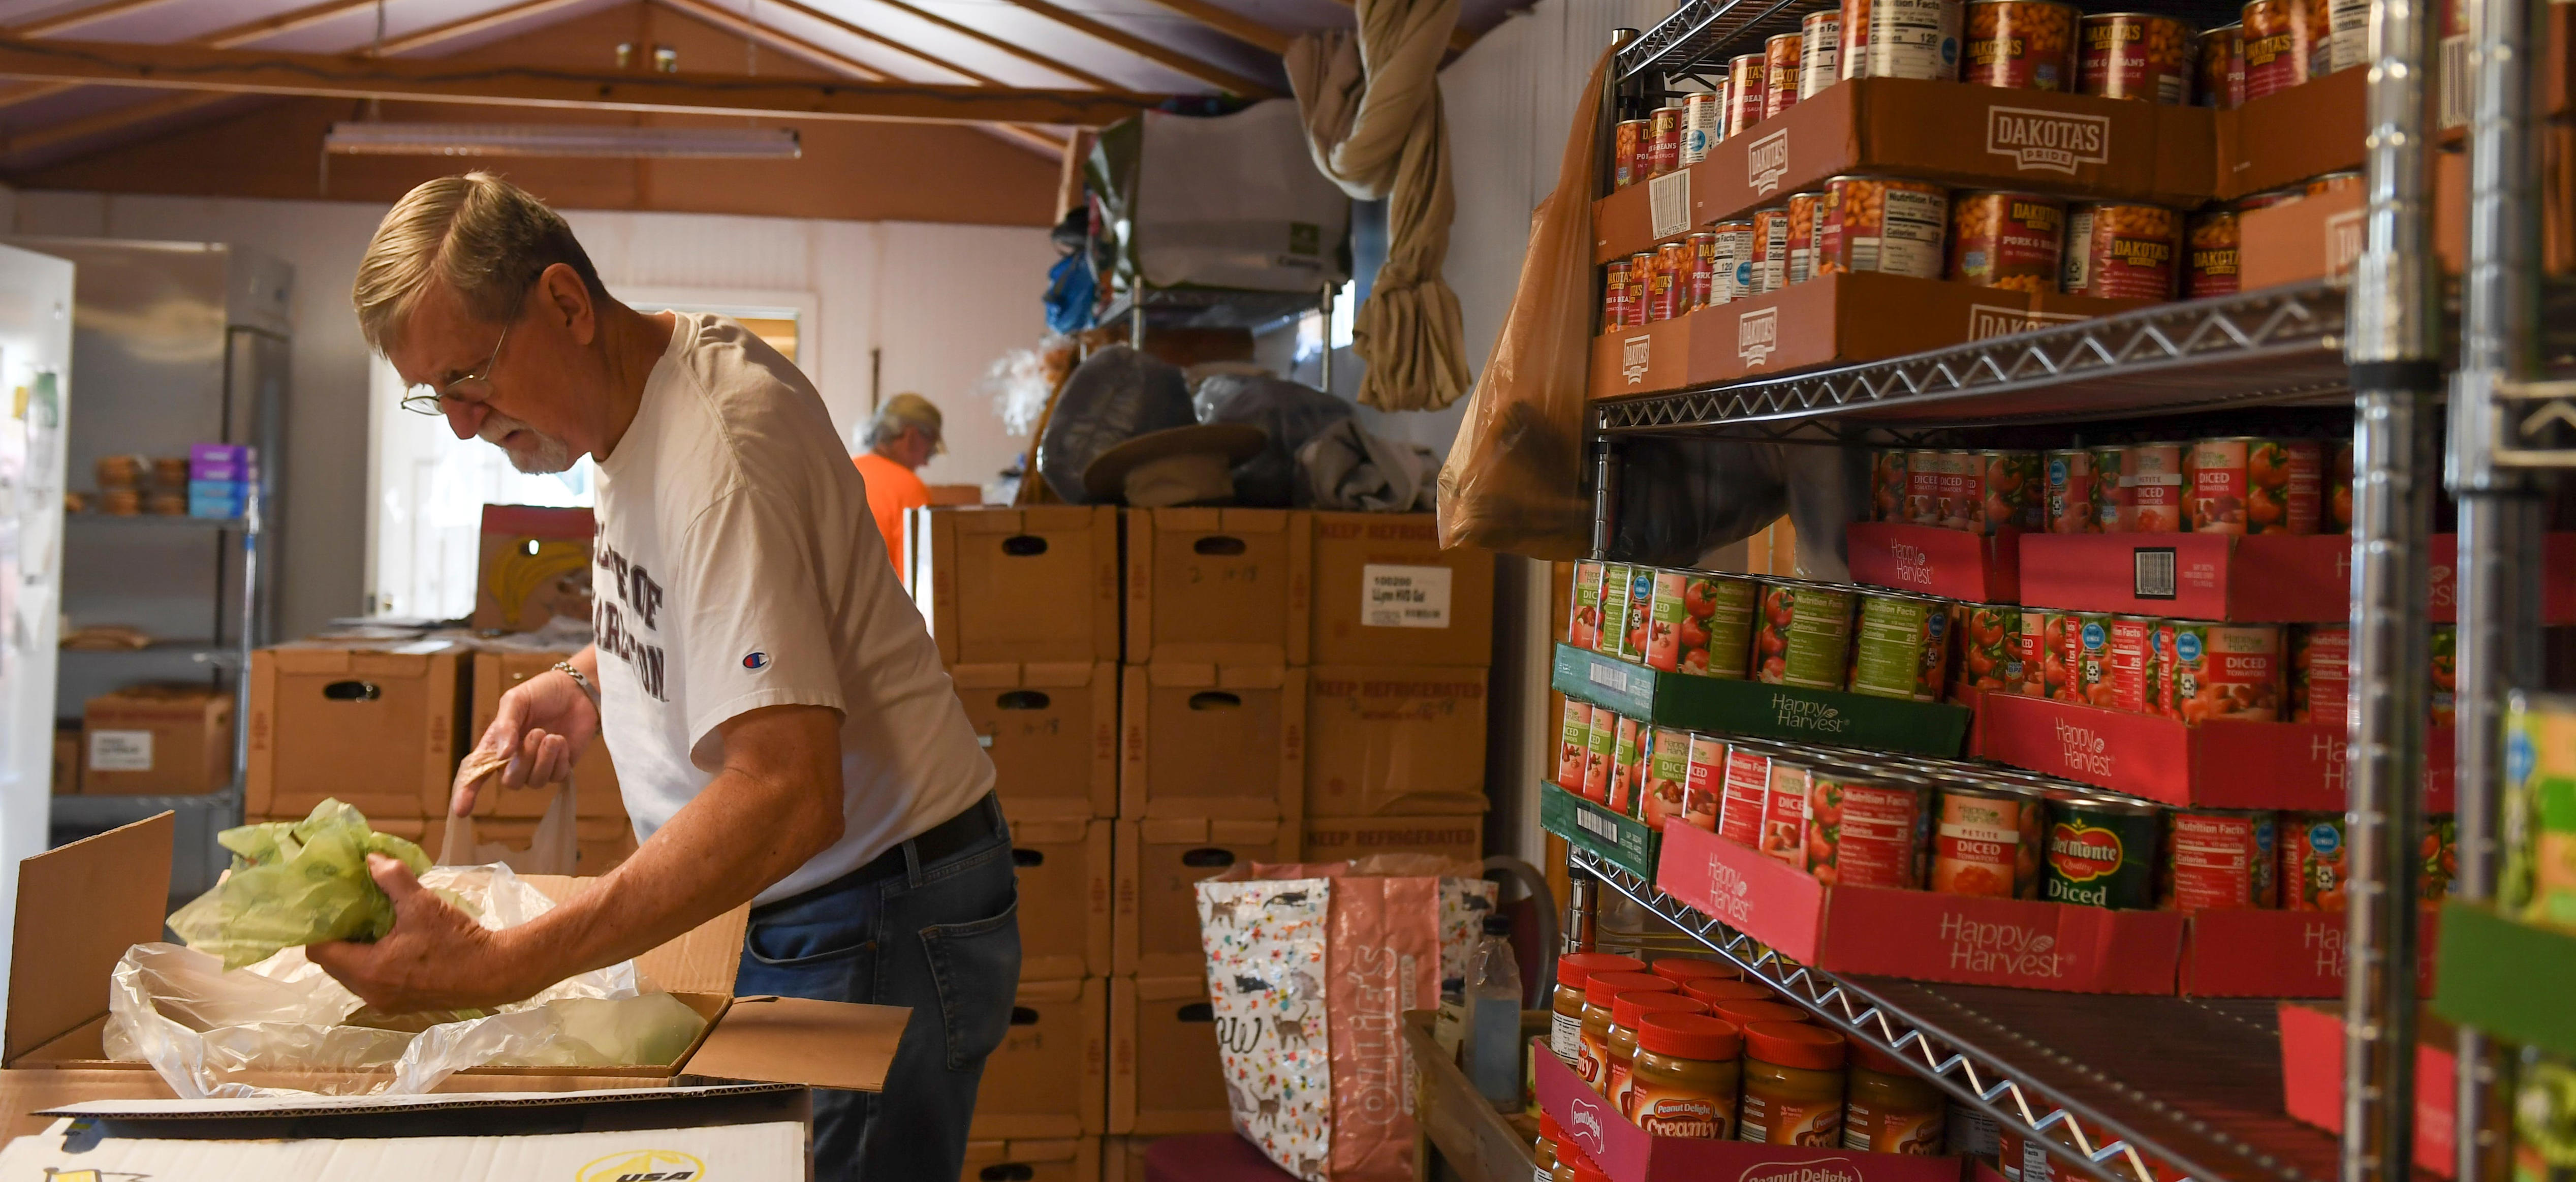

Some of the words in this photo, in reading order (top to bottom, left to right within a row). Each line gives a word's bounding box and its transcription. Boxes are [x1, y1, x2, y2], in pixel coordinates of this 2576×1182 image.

[1921, 34, 1937, 43] 120
[1998, 116, 2100, 152] DAKOTA'S
[1751, 141, 1786, 174] DAKOTA'S
[2022, 148, 2073, 165] PRIDE
[1890, 192, 1927, 203] Nutrition
[2003, 236, 2032, 245] PORK
[1722, 263, 1733, 271] 120
[1625, 341, 1648, 367] DAKOTA'S
[1940, 477, 1962, 486] DICED
[2199, 473, 2229, 484] DICED
[2138, 488, 2164, 499] DICED
[1320, 524, 1362, 540] KEEP
[1891, 538, 1919, 566] Happy
[1897, 559, 1932, 585] Harvest
[631, 564, 663, 631] OF
[1797, 596, 1827, 607] Nutrition
[1897, 606, 1916, 616] Facts
[1793, 623, 1817, 632] Calories
[2123, 627, 2141, 637] Facts
[1864, 630, 1884, 638] Calories
[1906, 634, 1917, 642] 25
[2312, 635, 2351, 647] Nutrition
[2131, 657, 2141, 667] 25
[2226, 657, 2267, 669] DICED
[2312, 667, 2342, 678] Calories
[1316, 680, 1358, 697] KEEP
[1363, 681, 1483, 698] REFRIGERATED
[1772, 693, 1828, 718] Happy
[1778, 709, 1843, 733] Harvest
[2056, 717, 2095, 753] Happy
[2063, 742, 2112, 777] Harvest
[1845, 791, 1886, 805] Nutrition
[1887, 794, 1910, 806] Facts
[1842, 824, 1873, 836] Calories
[1962, 828, 1998, 839] PETITE
[2178, 821, 2217, 833] Nutrition
[2219, 824, 2245, 834] Facts
[1308, 831, 1350, 847] KEEP
[1357, 829, 1476, 846] REFRIGERATED
[1957, 841, 2001, 855] DICED
[2053, 836, 2068, 854] Del
[2069, 841, 2117, 862] Monte
[1957, 852, 2000, 863] TOMATOES
[2178, 854, 2207, 864] Calories
[2233, 856, 2245, 866] 25
[1708, 853, 1742, 896] Happy
[2048, 878, 2107, 906] Diced
[1711, 881, 1751, 923] Harvest
[1941, 913, 2034, 951] Happy
[1951, 942, 2063, 978] Harvest
[1657, 1104, 1683, 1114] Peanut
[1684, 1103, 1711, 1115] Delight
[1574, 1111, 1586, 1125] Peanut
[1586, 1110, 1600, 1140] Delight
[1647, 1118, 1719, 1139] Creamy
[2025, 1149, 2038, 1157] Facts
[616, 1171, 695, 1182] USA
